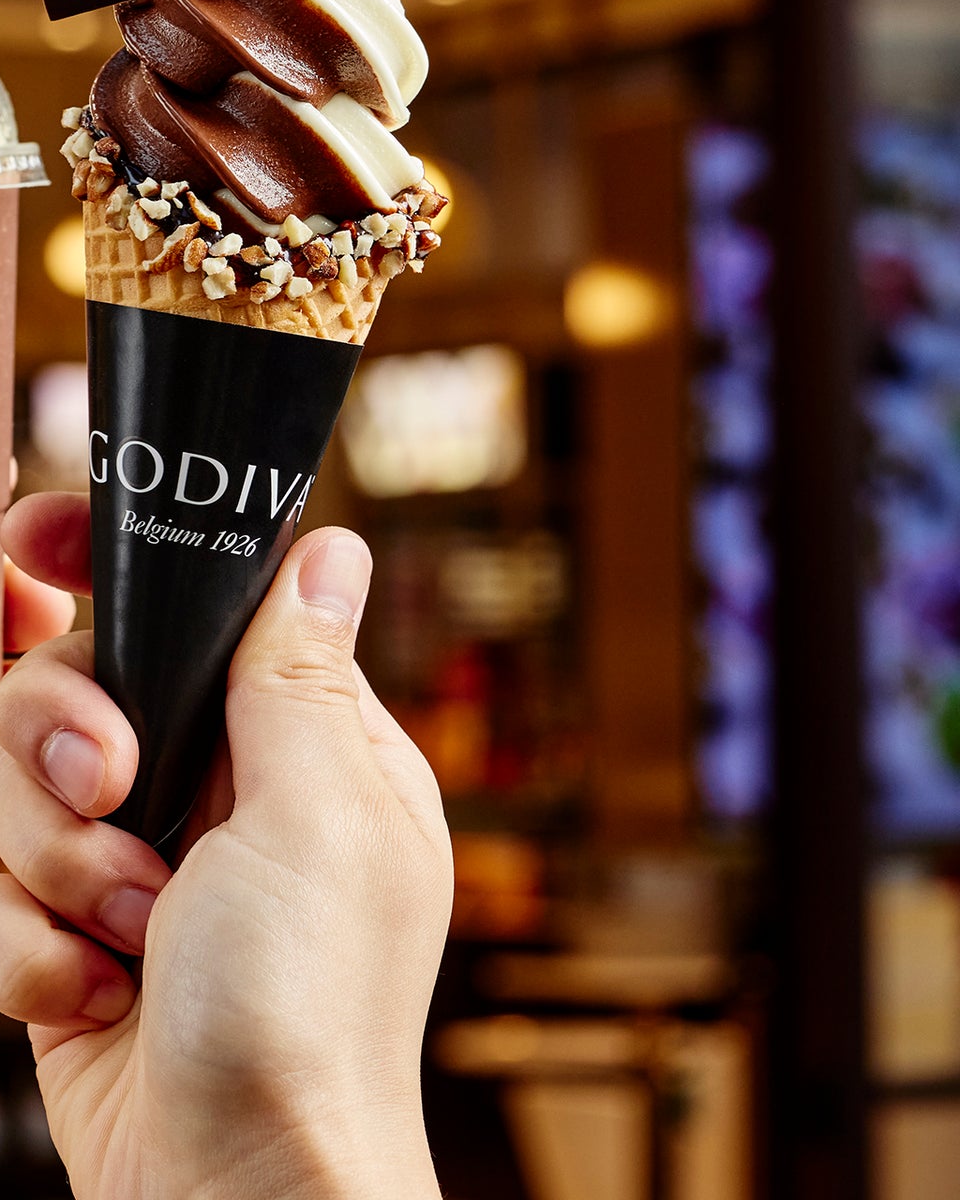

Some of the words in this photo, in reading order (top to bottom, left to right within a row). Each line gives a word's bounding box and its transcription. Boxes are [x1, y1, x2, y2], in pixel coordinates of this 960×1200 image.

[89, 429, 313, 523] GODIVA
[119, 509, 206, 546] Belgium
[209, 529, 262, 558] 1926
